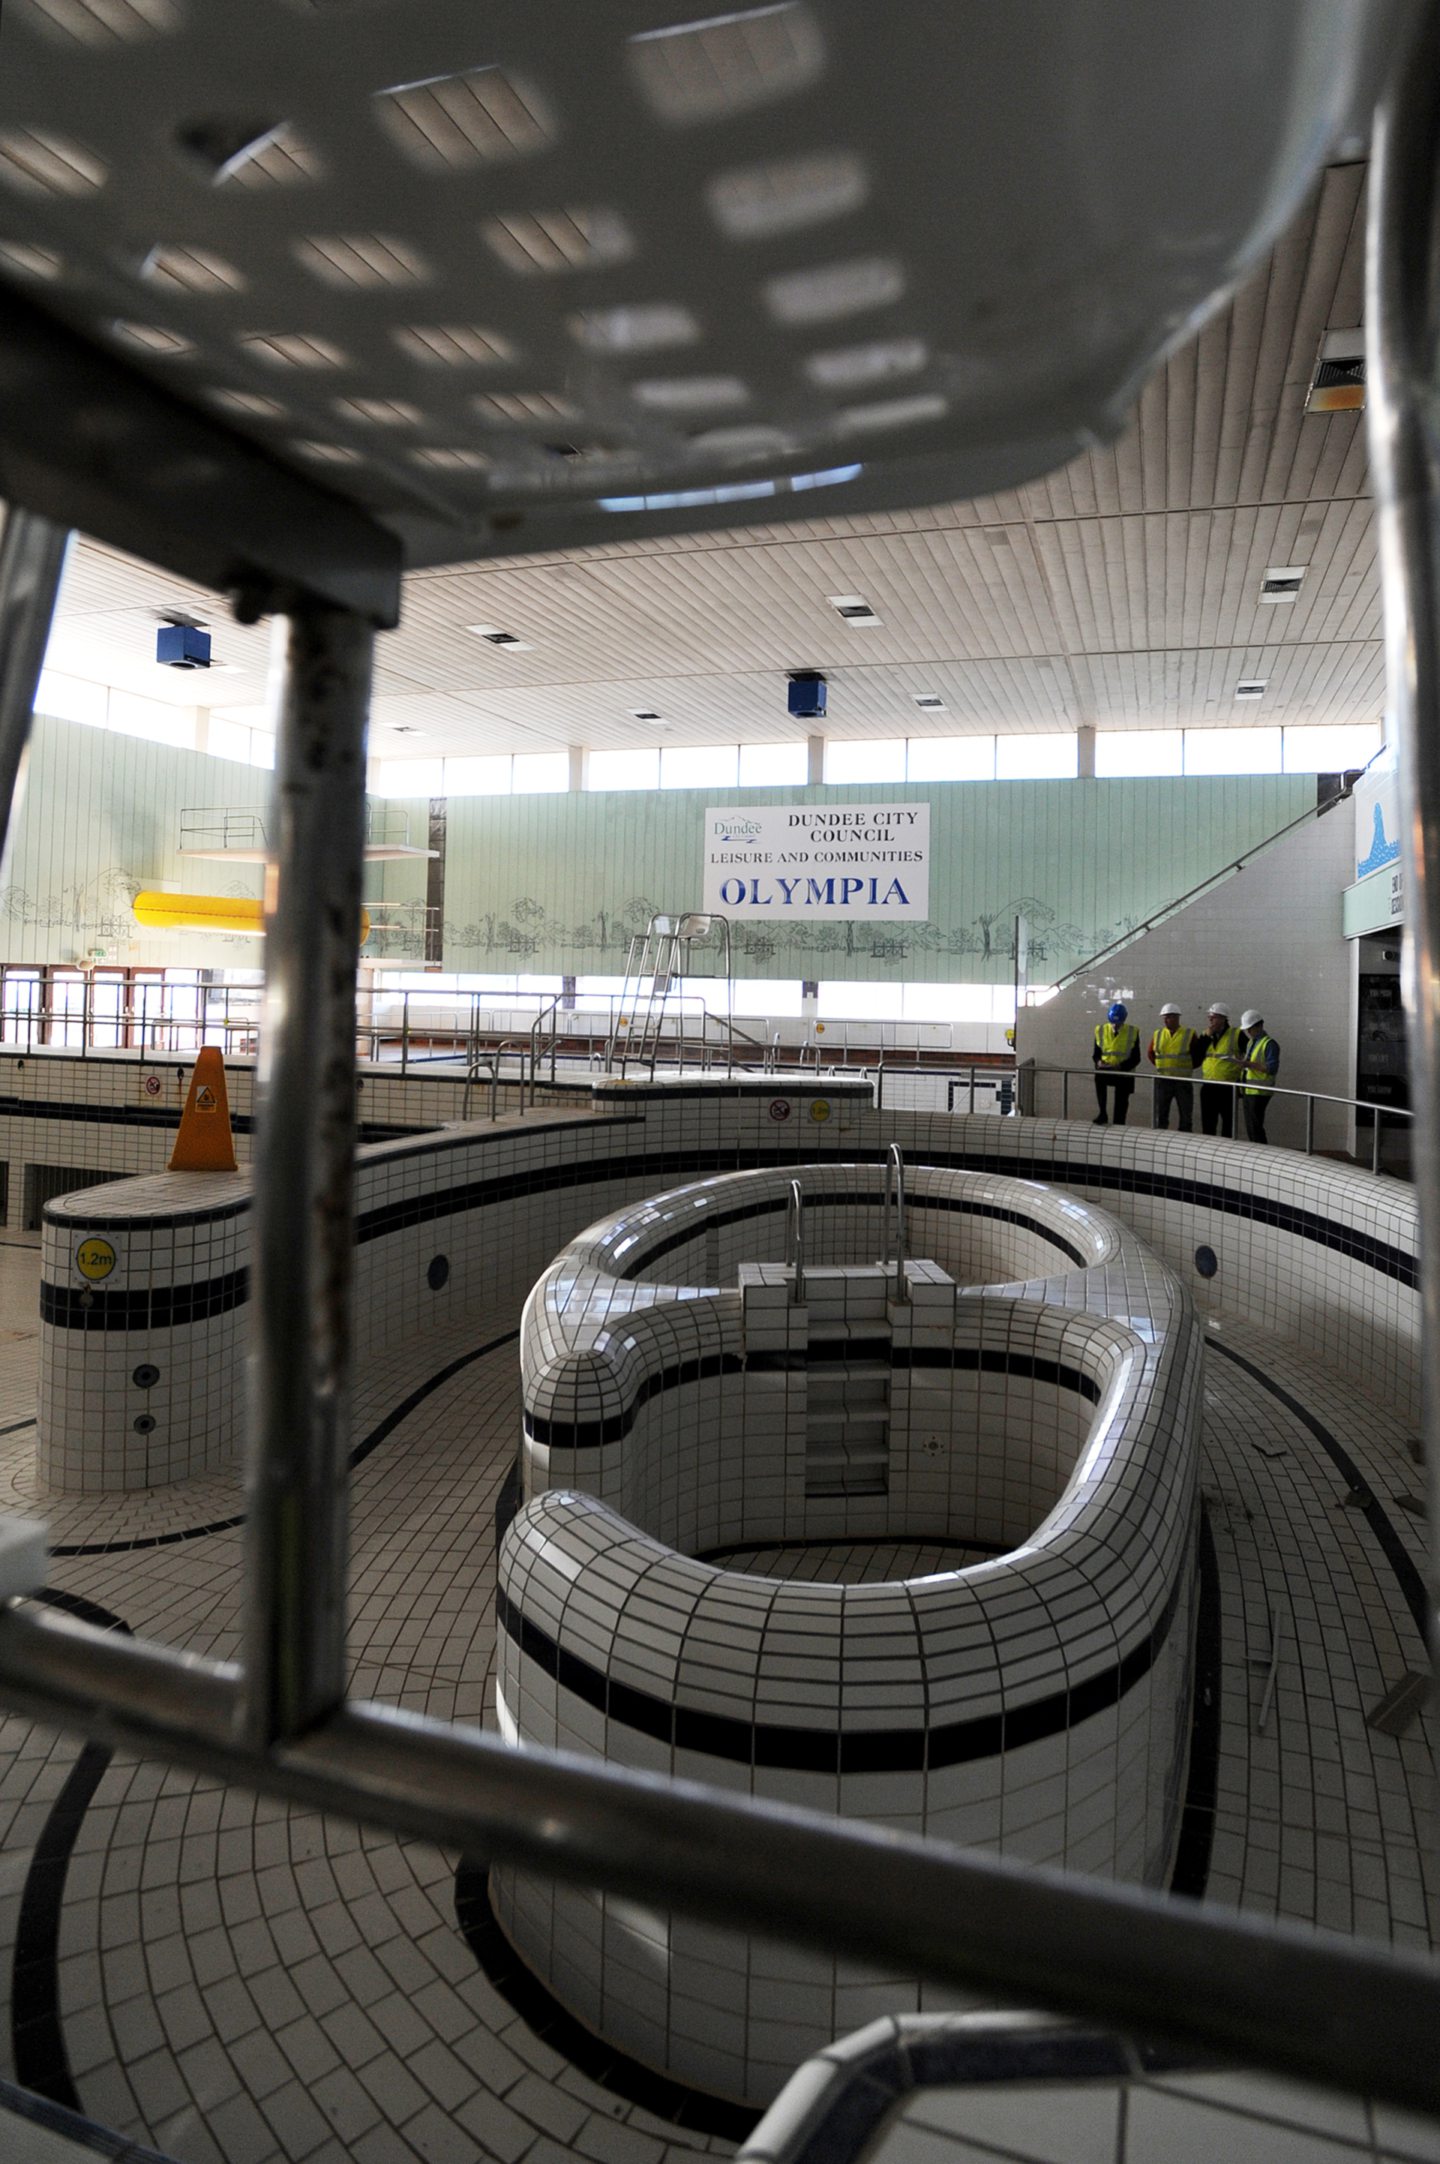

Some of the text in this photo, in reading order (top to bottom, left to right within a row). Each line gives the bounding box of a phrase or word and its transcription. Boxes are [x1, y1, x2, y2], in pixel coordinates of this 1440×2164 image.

[788, 811, 919, 827] DUNDEE CITY
[714, 820, 762, 835] Dundee
[810, 829, 895, 842] COUNCIL
[711, 850, 923, 864] LEISURE AND COMMUNITIES
[719, 876, 911, 906] OLYMPIA
[80, 1252, 112, 1265] 1.2m
